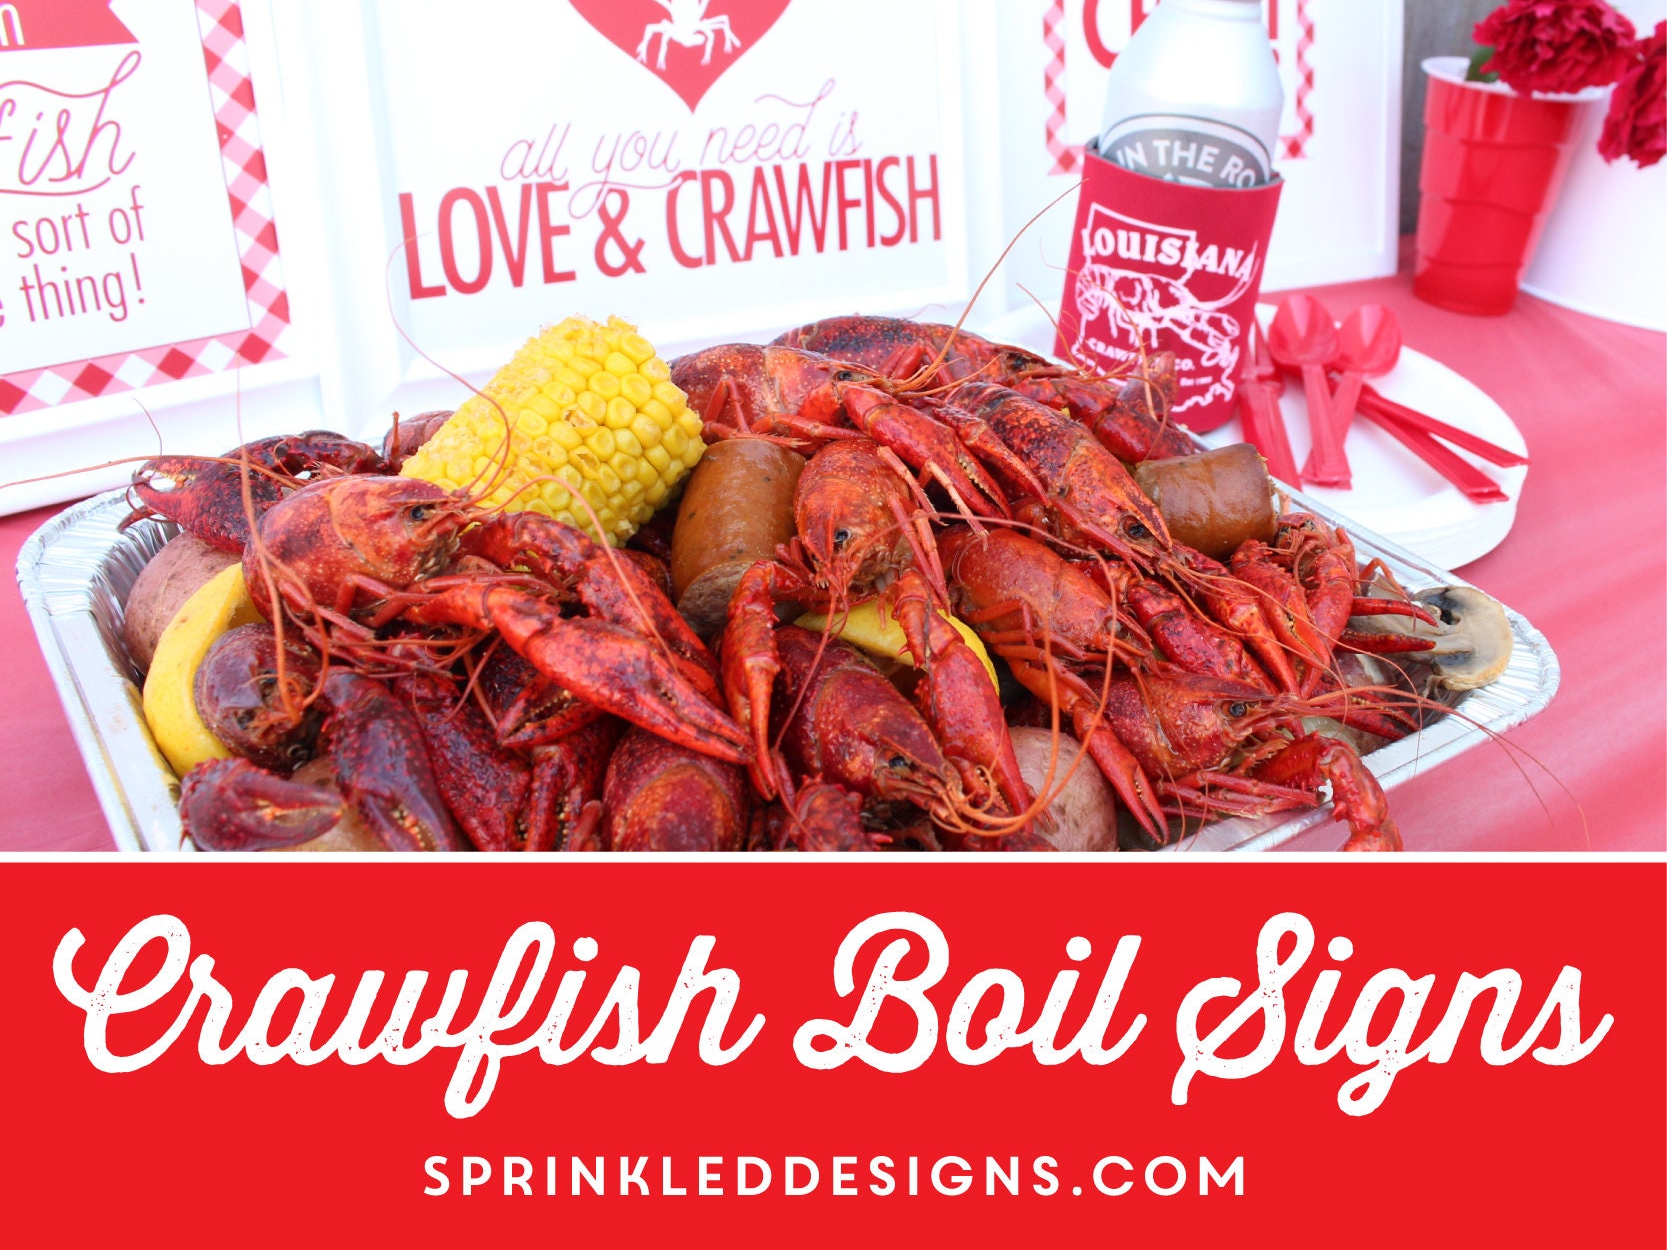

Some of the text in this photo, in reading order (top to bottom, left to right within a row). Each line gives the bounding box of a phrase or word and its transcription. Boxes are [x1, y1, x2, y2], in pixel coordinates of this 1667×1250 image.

[500, 78, 862, 219] all you need is
[1116, 141, 1149, 170] IN
[1152, 139, 1219, 174] THE
[12, 185, 144, 259] sort of
[399, 154, 942, 300] LOVE & CRAWFISH
[1081, 227, 1254, 282] LOUISIANA
[19, 252, 146, 322] thing!
